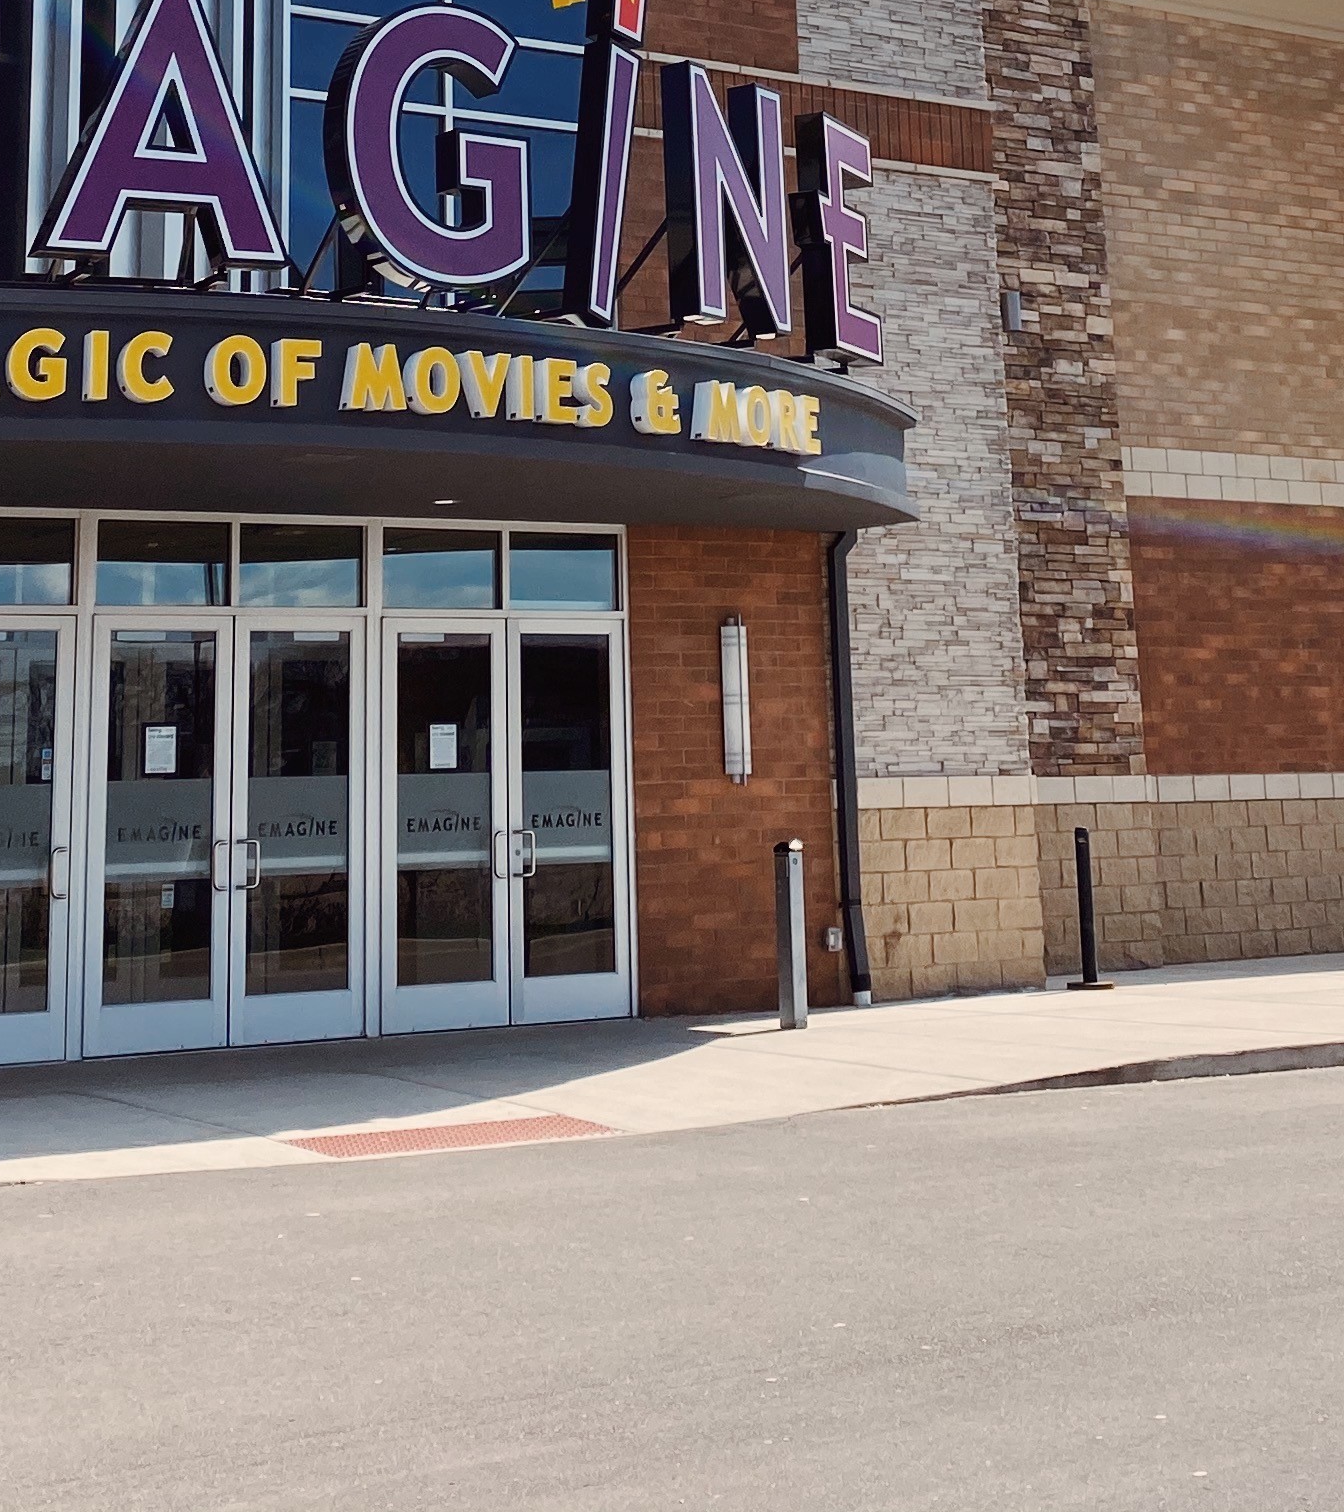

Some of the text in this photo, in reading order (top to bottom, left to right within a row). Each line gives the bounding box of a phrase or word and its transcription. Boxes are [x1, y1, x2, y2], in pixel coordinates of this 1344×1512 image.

[203, 334, 323, 408] OF
[338, 341, 615, 428] MOVIES
[631, 369, 682, 436] &
[690, 378, 823, 457] MORE
